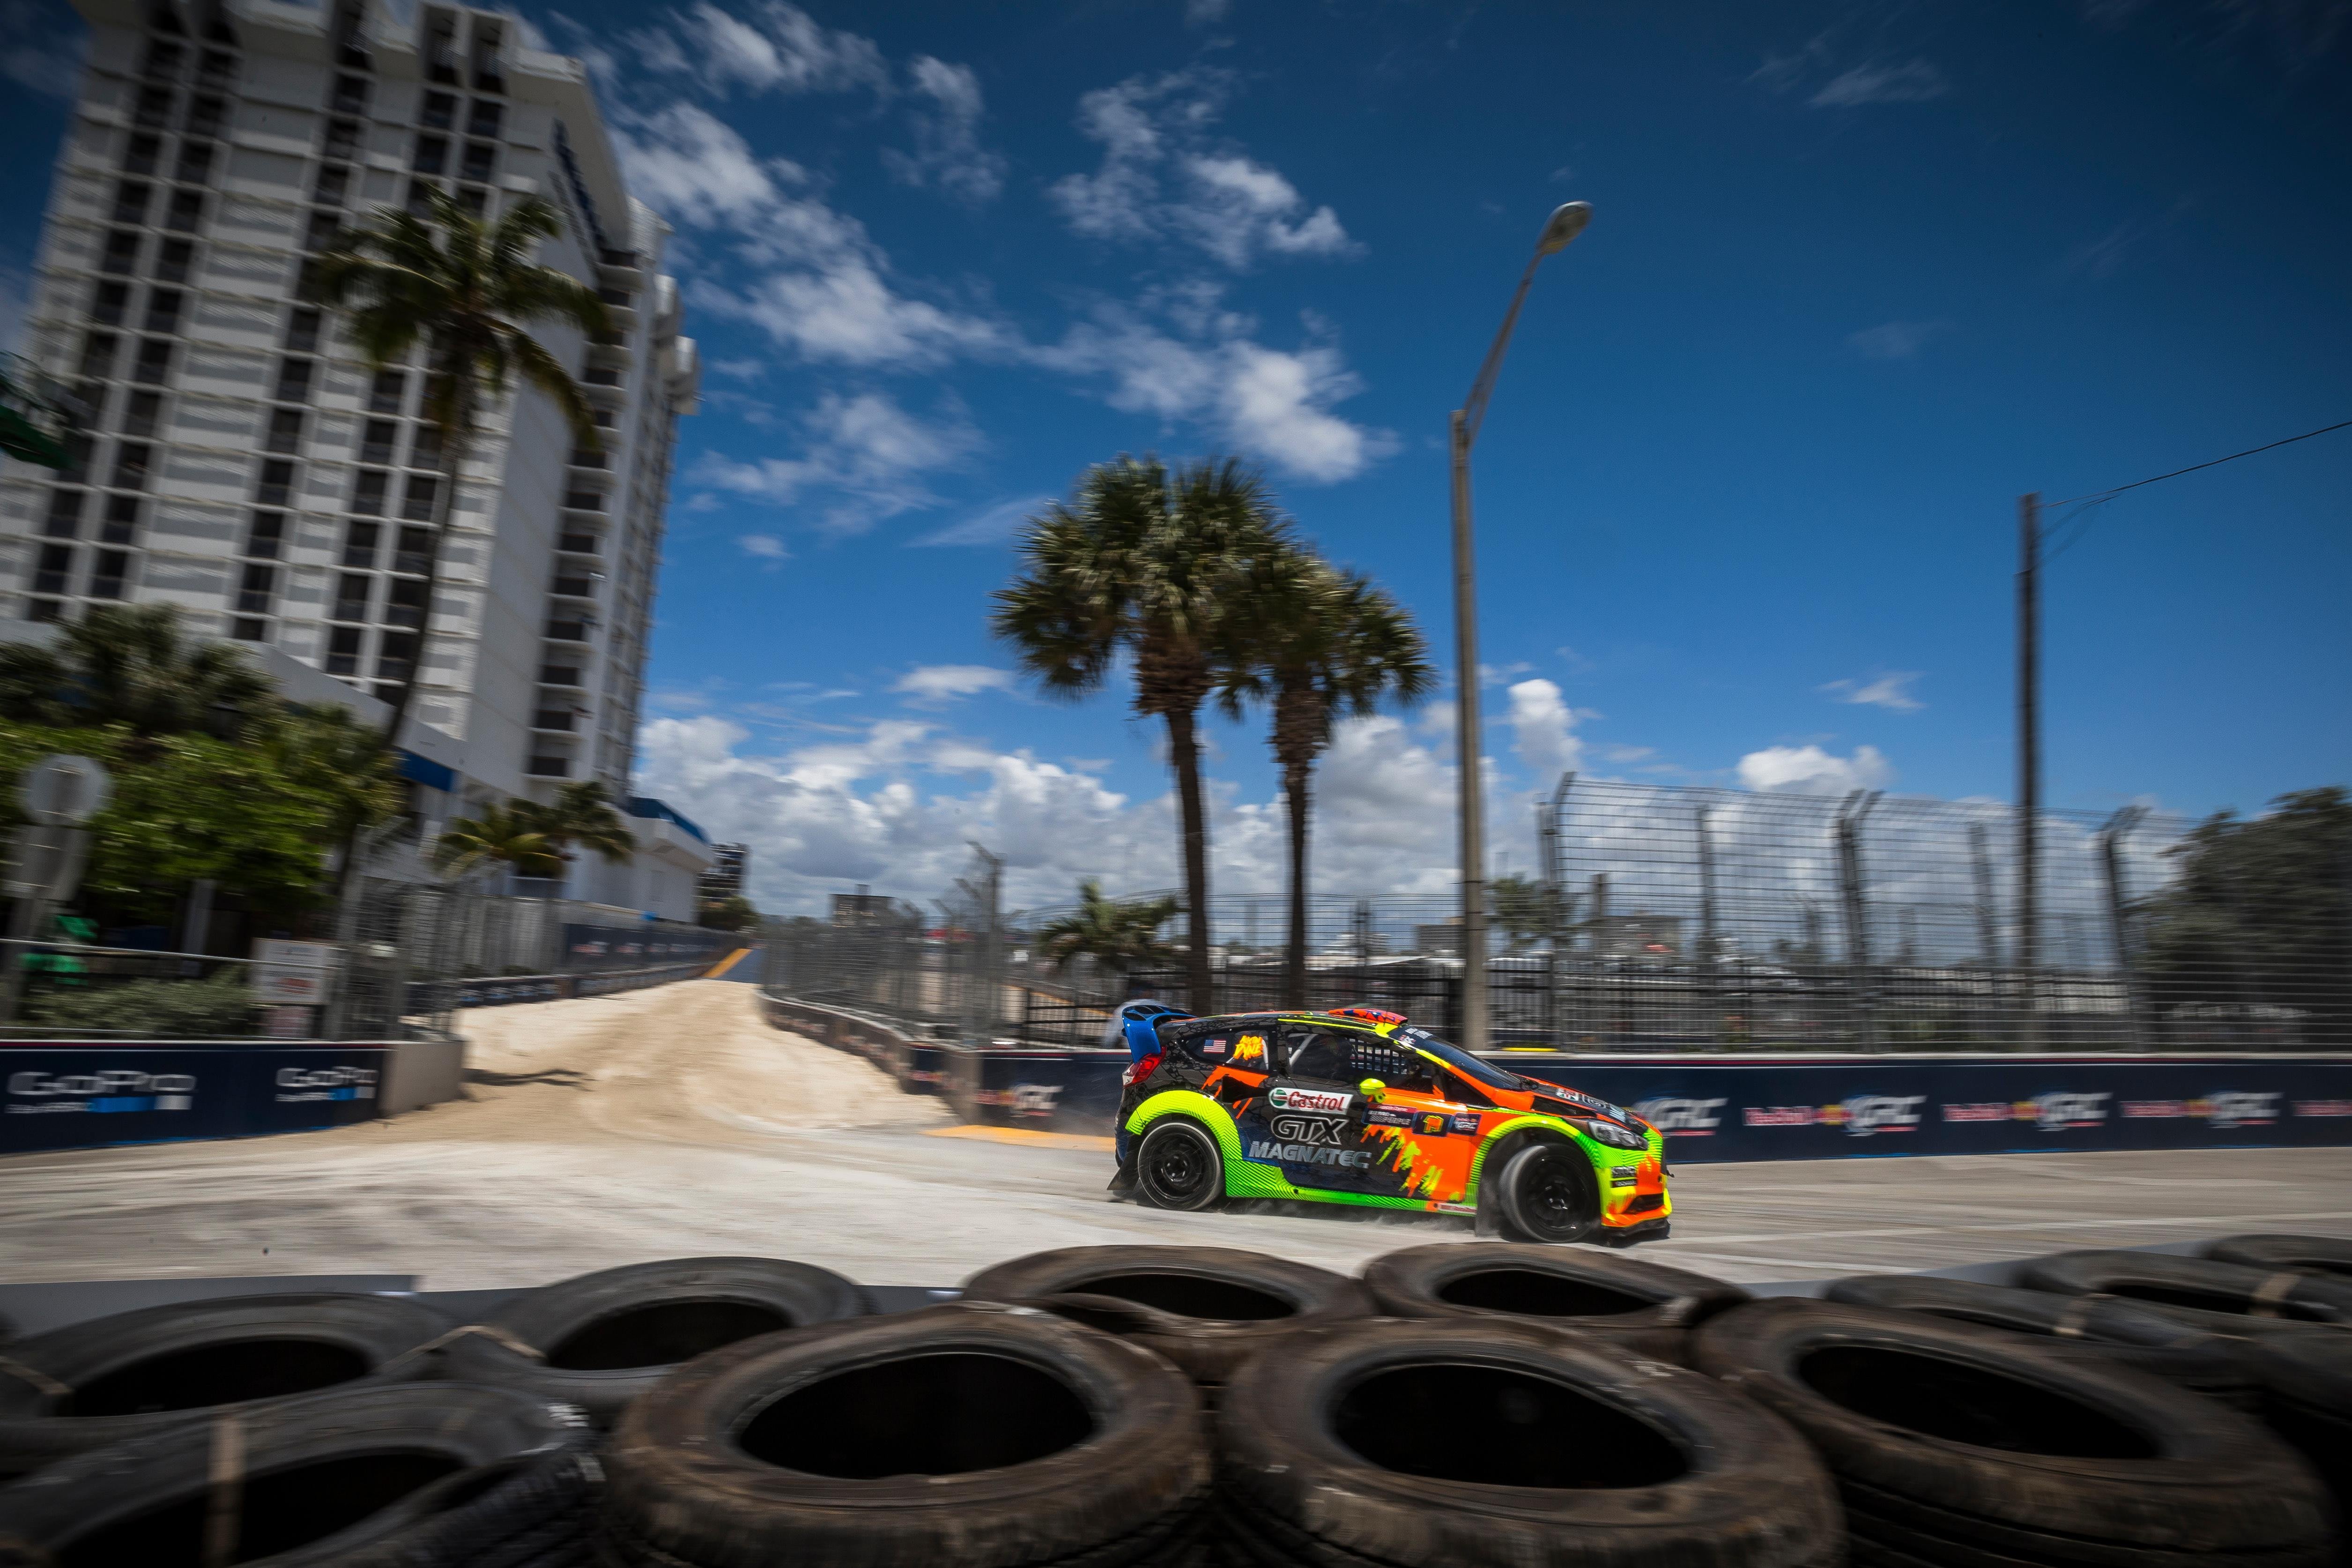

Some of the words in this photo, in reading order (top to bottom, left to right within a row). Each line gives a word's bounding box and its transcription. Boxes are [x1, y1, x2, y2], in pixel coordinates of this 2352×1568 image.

[7, 1070, 197, 1095] GoPro
[275, 1066, 379, 1087] GoPro
[1288, 1091, 1345, 1112] Castrol
[1270, 1114, 1350, 1145] GTX
[1248, 1140, 1373, 1169] MAGNATEC
